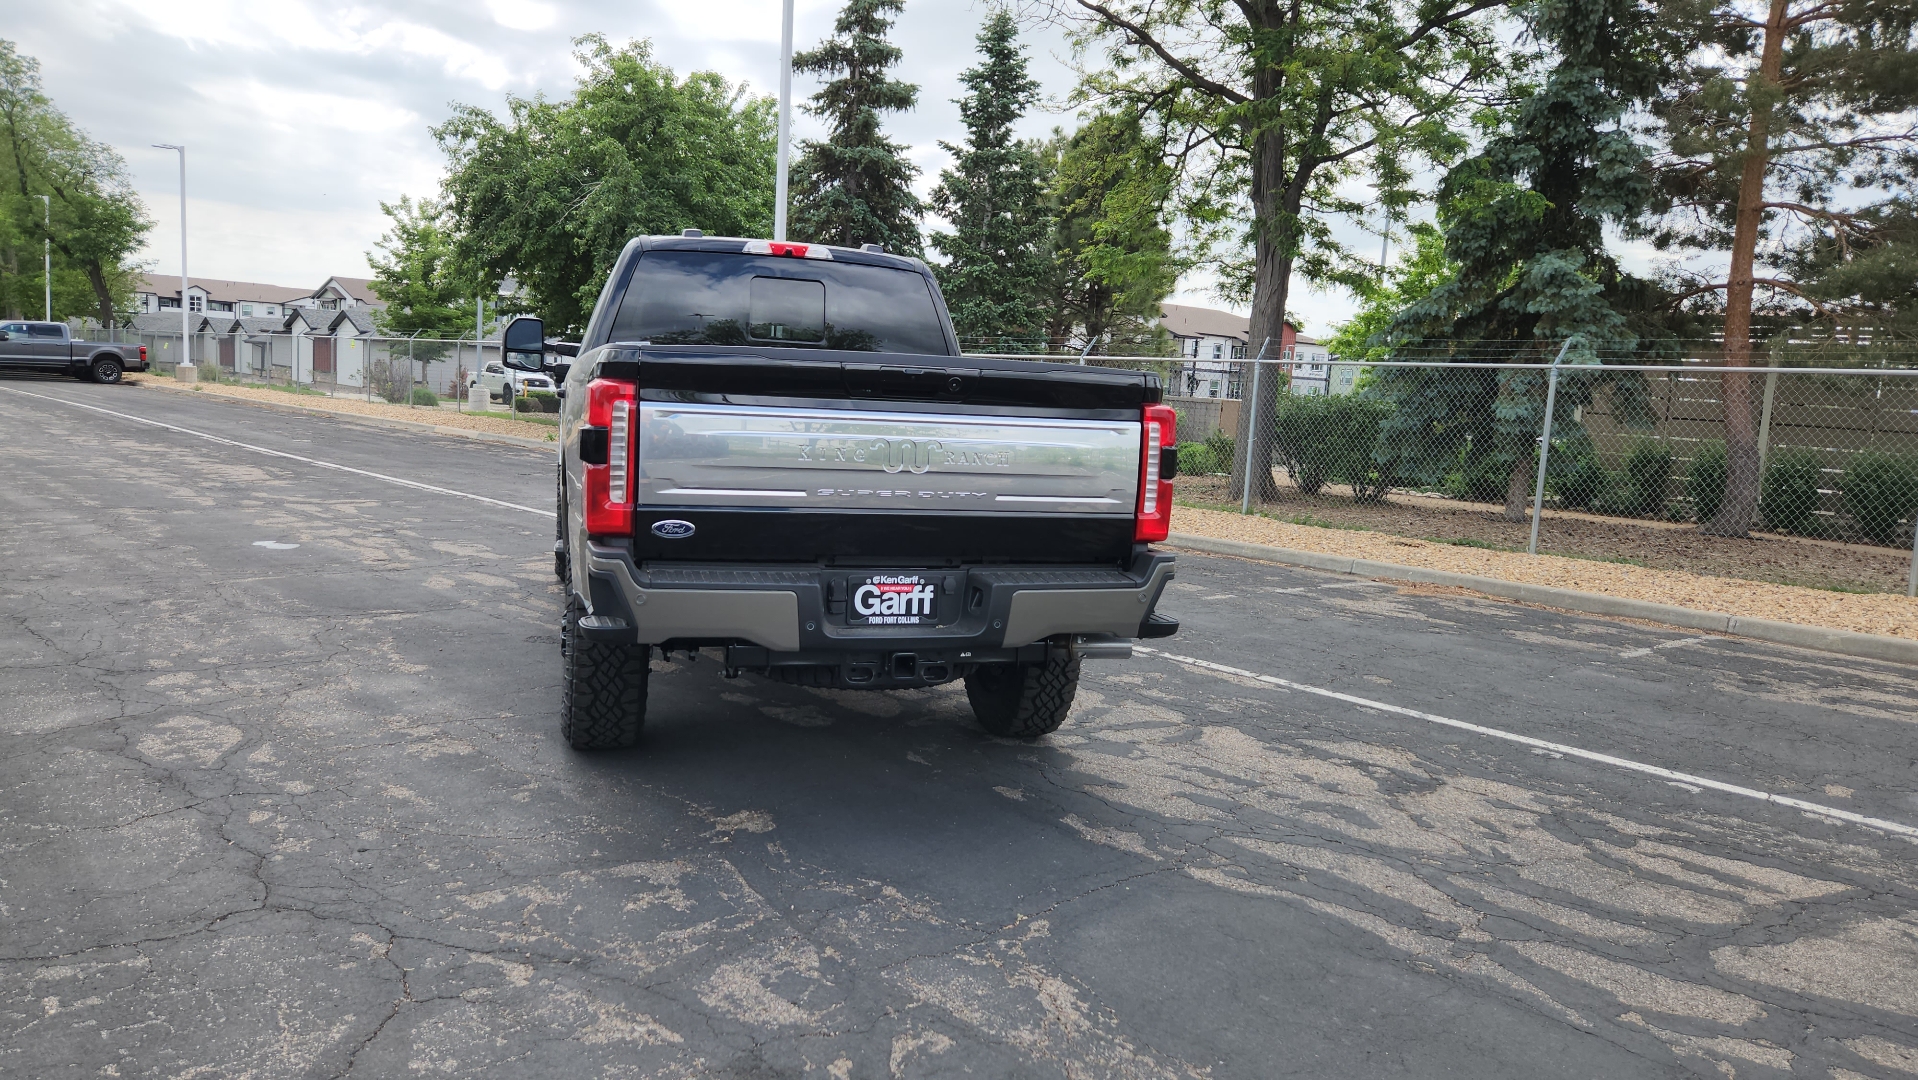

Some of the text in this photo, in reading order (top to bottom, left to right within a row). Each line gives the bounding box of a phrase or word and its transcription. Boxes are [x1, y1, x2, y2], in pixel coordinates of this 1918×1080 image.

[798, 444, 1010, 467] KING RANCH
[817, 487, 988, 500] SUPER DUTY
[661, 523, 686, 534] Ford
[880, 575, 919, 584] Ken Garff
[854, 584, 934, 616] Garff
[868, 616, 920, 624] FORD FORT COLLINS
